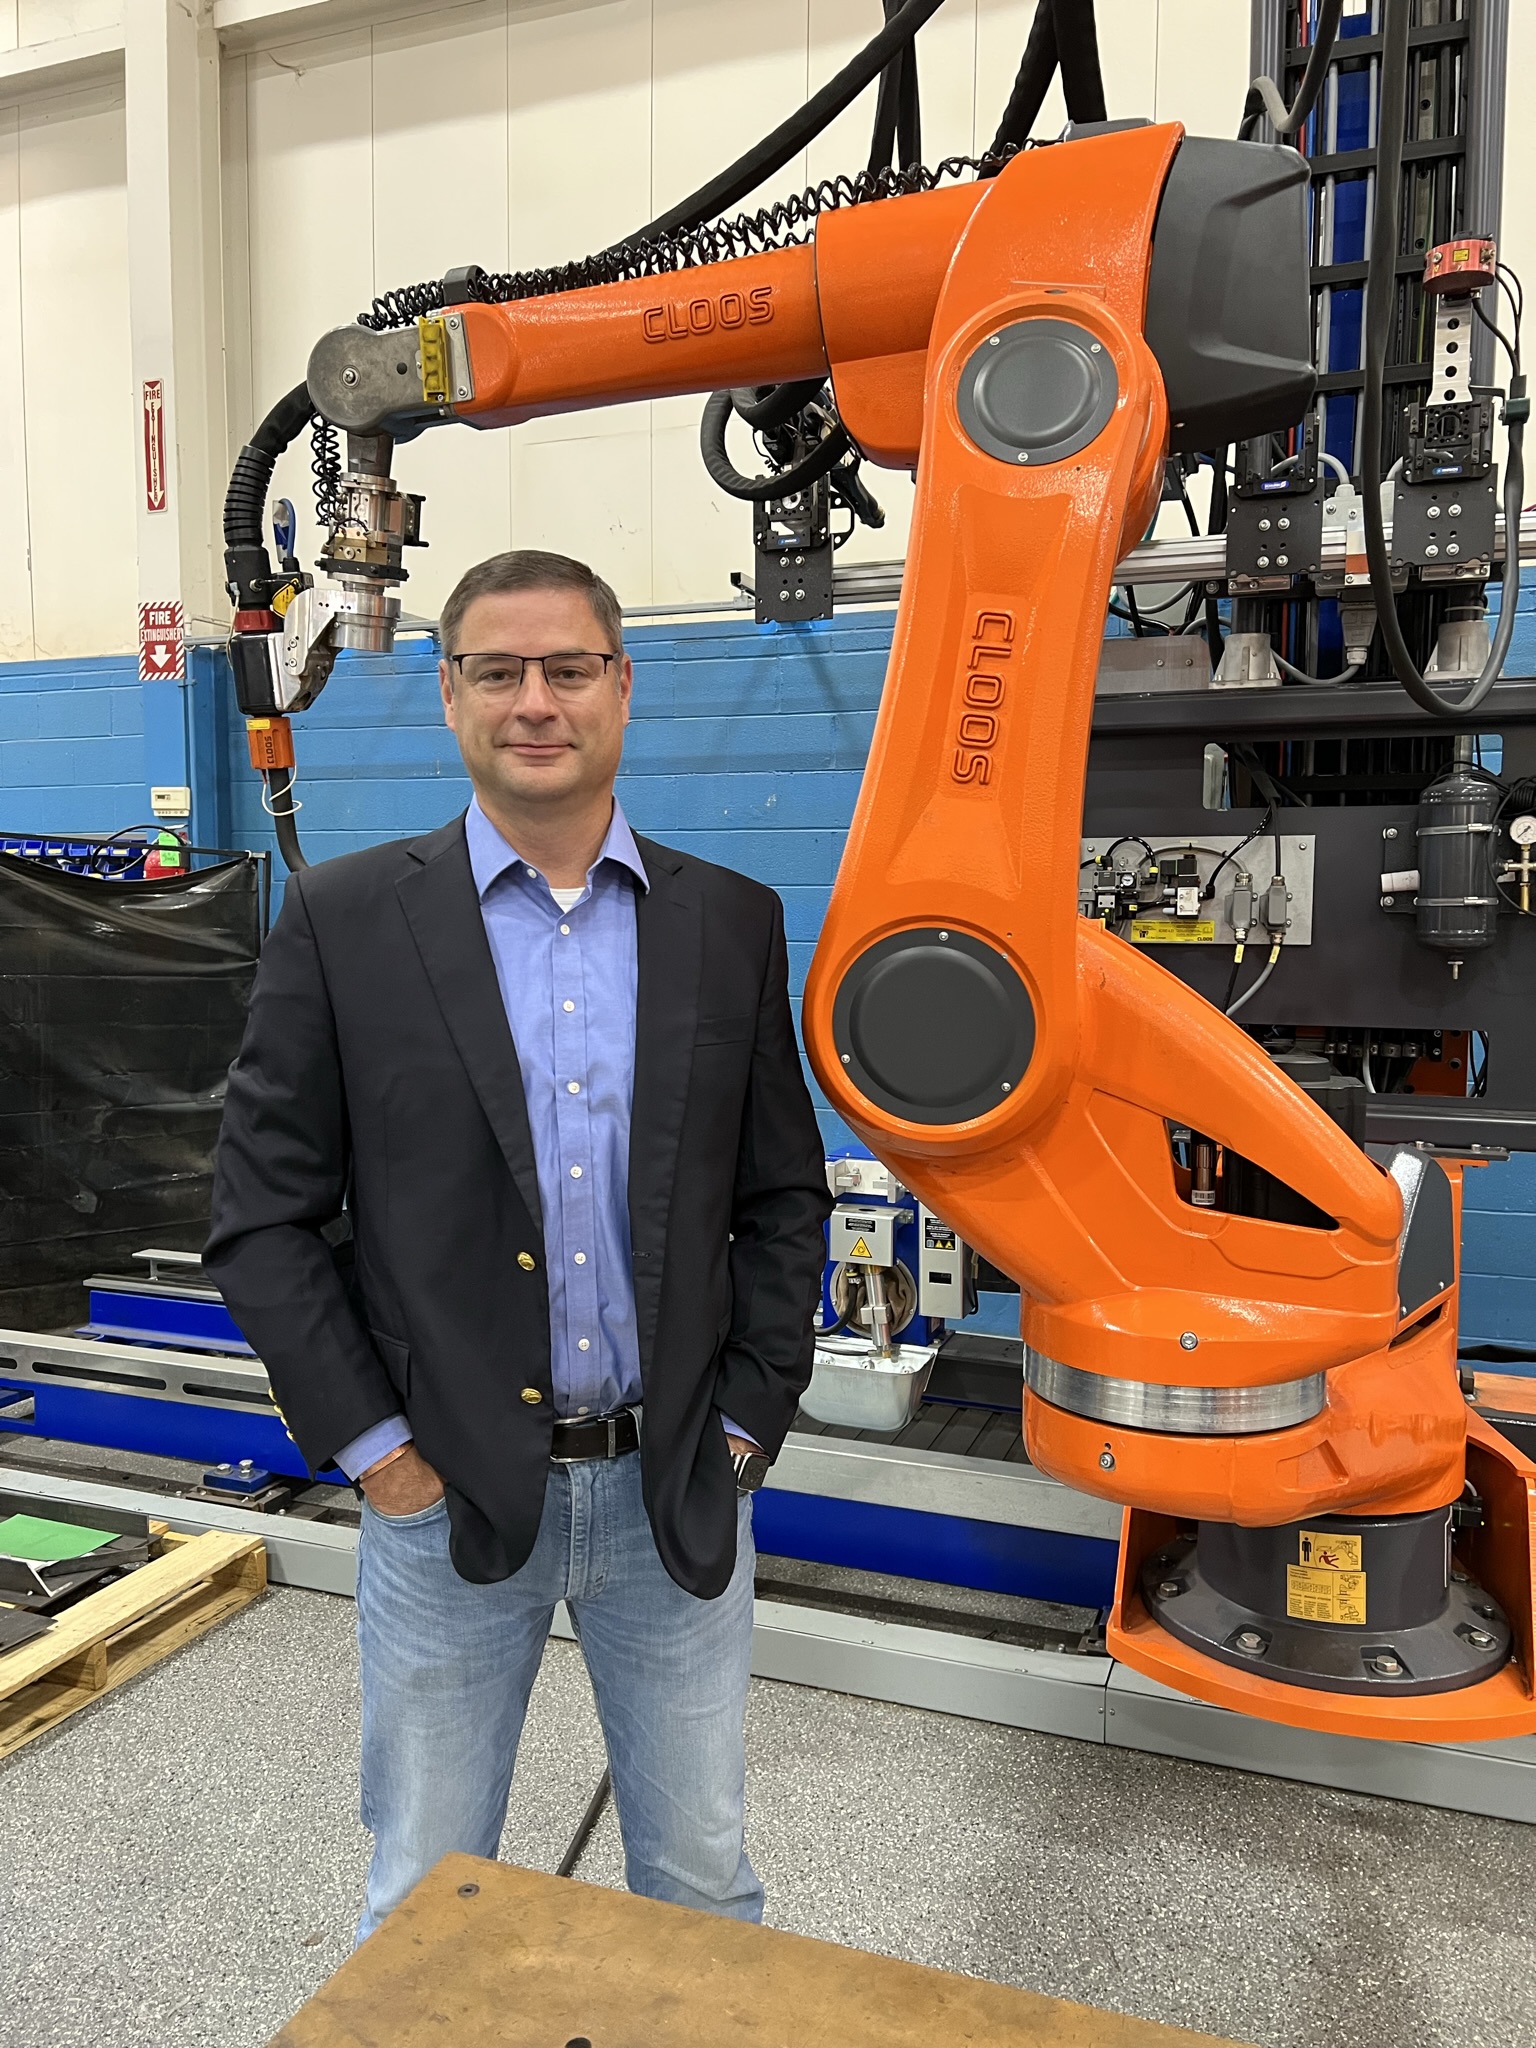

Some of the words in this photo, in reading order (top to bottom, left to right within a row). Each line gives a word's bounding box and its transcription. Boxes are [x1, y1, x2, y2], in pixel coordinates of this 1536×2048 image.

[643, 286, 774, 343] CLOOS
[145, 389, 161, 400] FIRE
[149, 610, 172, 626] FIRE
[140, 627, 183, 642] EXTINGUISHER
[951, 610, 1015, 786] CLOOS
[264, 735, 275, 764] CLOOS
